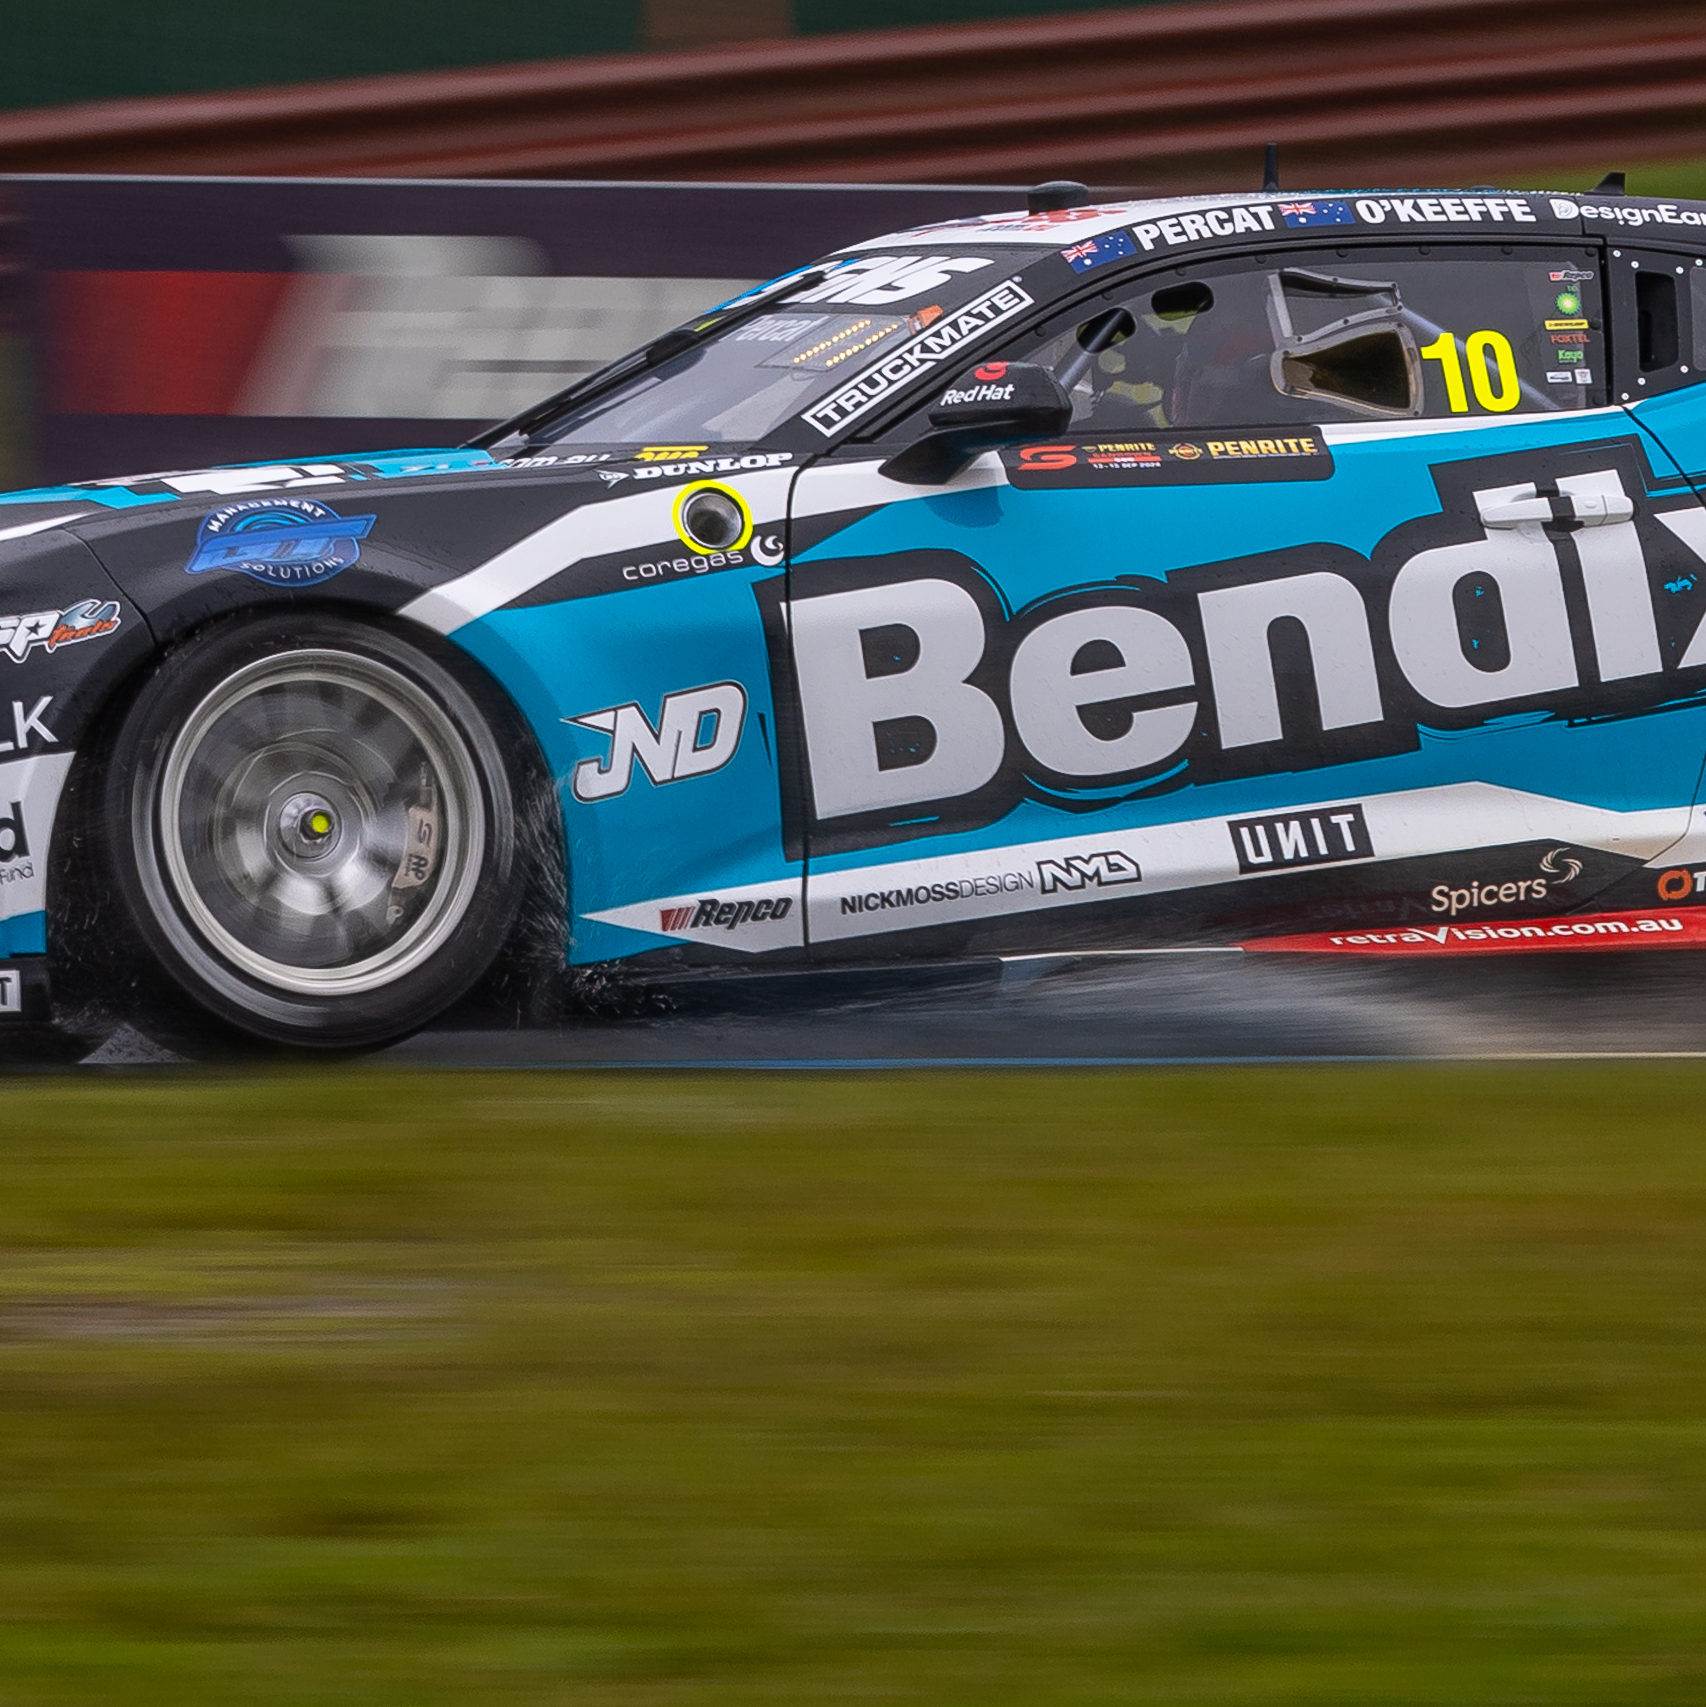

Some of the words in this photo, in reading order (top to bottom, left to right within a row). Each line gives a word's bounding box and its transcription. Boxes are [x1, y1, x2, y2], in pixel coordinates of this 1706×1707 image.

[1137, 205, 1276, 251] PERCAT
[1356, 197, 1536, 224] O'KEEFFE
[1550, 334, 1590, 344] FOXTEL
[816, 289, 1024, 426] TRUCKMATE
[1421, 330, 1521, 413] 10
[1206, 437, 1318, 456] PENRITE
[634, 453, 793, 480] DUNLOP
[240, 557, 345, 579] SOLUTIONS
[622, 550, 743, 581] coregas
[1238, 815, 1357, 865] UNIT
[841, 871, 1035, 915] NICKMOSSDESIGN
[1431, 877, 1547, 916] Spicers
[693, 896, 793, 930] Repco
[1329, 914, 1684, 947] retraVision.com.au
